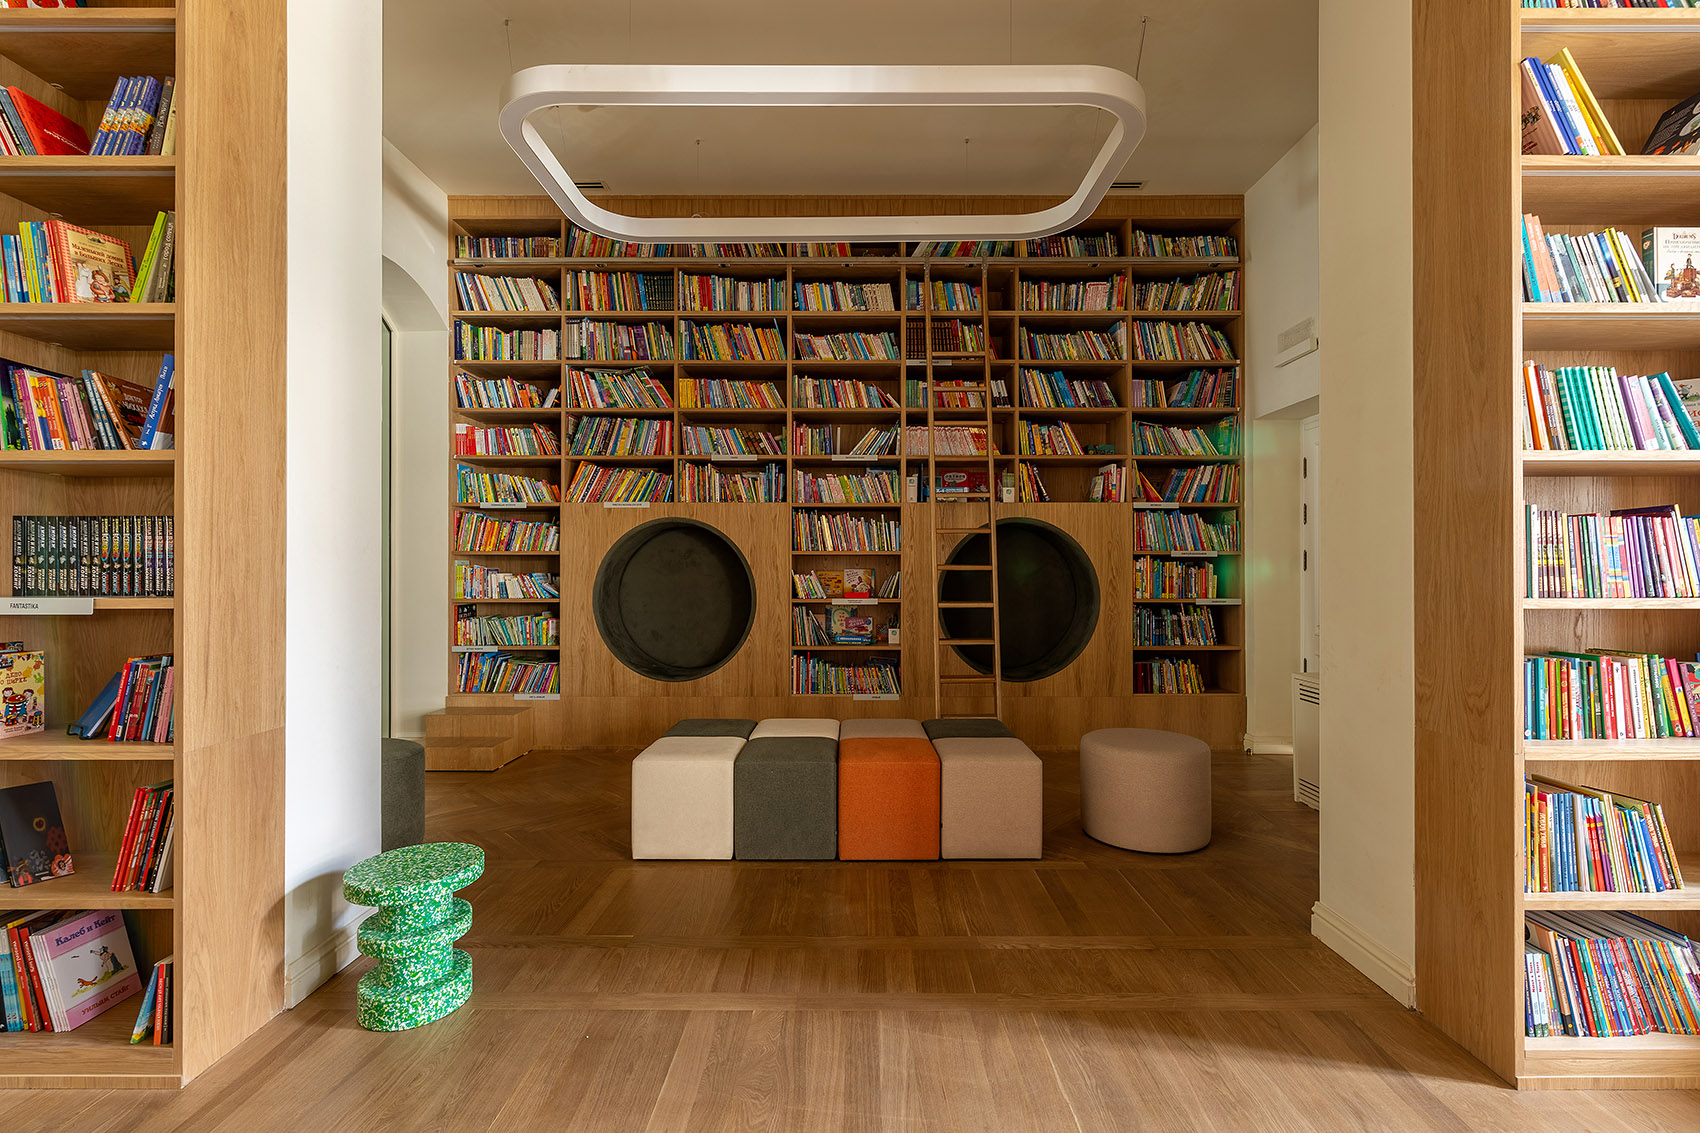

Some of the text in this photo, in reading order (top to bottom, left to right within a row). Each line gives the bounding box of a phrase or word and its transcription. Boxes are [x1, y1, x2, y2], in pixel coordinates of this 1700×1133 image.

[71, 242, 106, 258] Маленький
[10, 602, 39, 610] FANTASTIKA
[6, 677, 27, 685] ЦИРКЕ
[54, 914, 116, 947] Калеб и Кейт
[81, 984, 130, 1016] УИЛЬЯМ СТАЙГ
